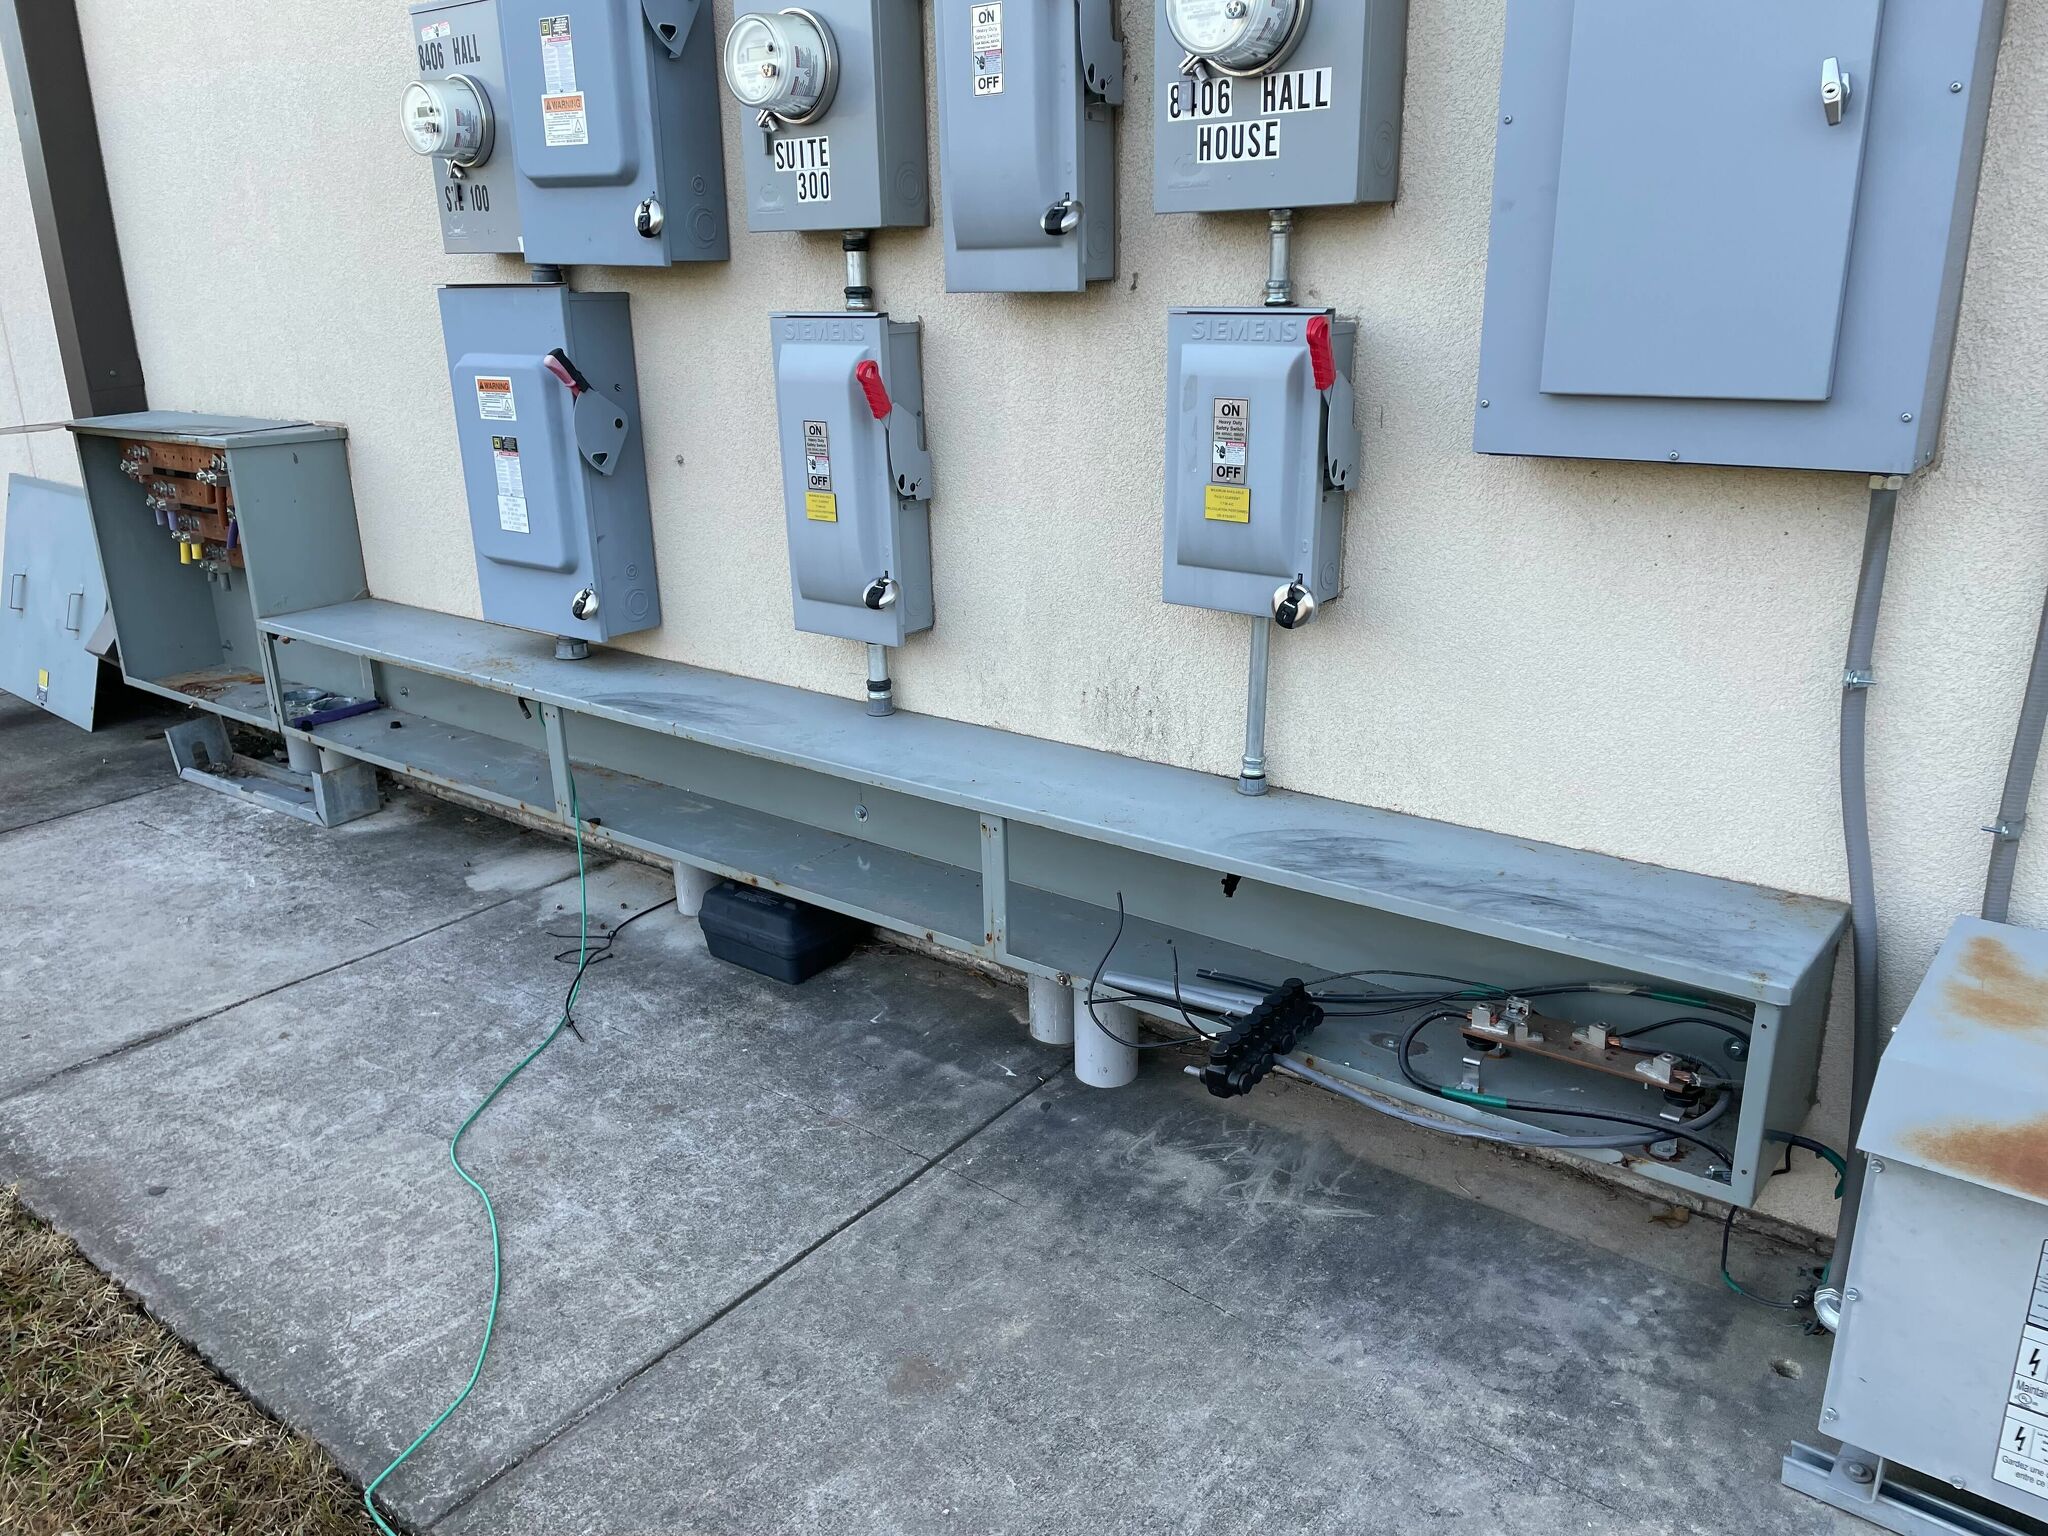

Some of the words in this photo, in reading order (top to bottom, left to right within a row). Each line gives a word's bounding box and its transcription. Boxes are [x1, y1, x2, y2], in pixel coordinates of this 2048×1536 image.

[979, 10, 995, 24] ON
[418, 42, 444, 71] 8406
[452, 34, 481, 65] HALL
[978, 76, 1000, 90] OFF
[1263, 71, 1328, 113] HALL
[551, 98, 582, 111] WARNING
[1199, 121, 1278, 162] HOUSE
[775, 138, 829, 170] SUITE
[798, 171, 830, 200] 300
[470, 184, 490, 212] 100
[784, 320, 865, 342] SIEMENS
[1191, 319, 1297, 342] SIEMENS
[484, 382, 509, 391] WARNING
[1221, 404, 1240, 417] ON
[808, 425, 822, 436] ON
[810, 475, 828, 486] OFF
[1216, 465, 1242, 479] OFF
[2001, 1455, 2029, 1471] Gardez
[2029, 1466, 2045, 1477] une
[2015, 1471, 2035, 1484] entre
[2036, 1479, 2046, 1488] ce
